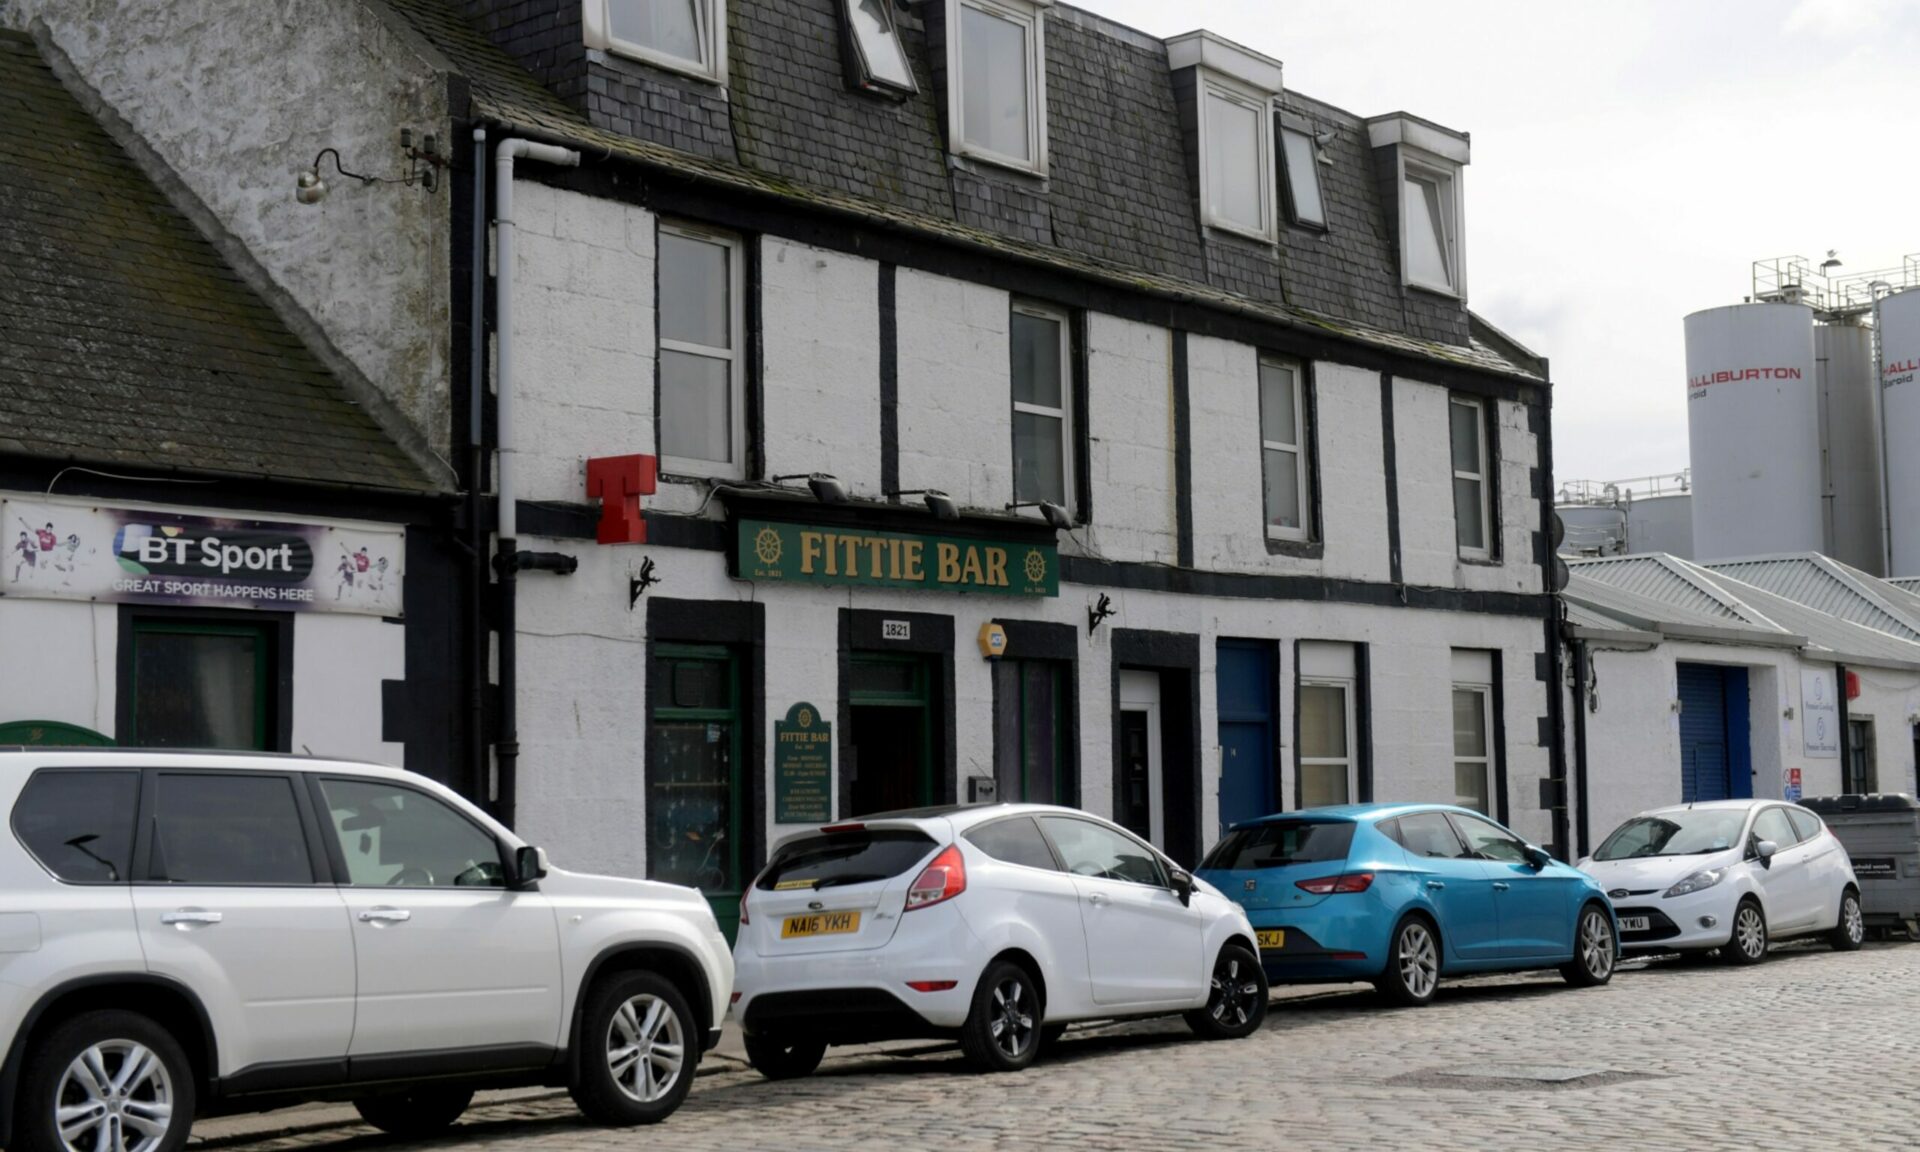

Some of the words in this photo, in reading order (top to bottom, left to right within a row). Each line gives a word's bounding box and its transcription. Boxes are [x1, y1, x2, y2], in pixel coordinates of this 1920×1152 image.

[1689, 368, 1801, 388] ALLIBURTON
[139, 536, 194, 565] BT
[200, 537, 293, 574] Sport
[800, 531, 925, 581] FITTIE
[936, 542, 1010, 587] BAR
[112, 579, 163, 594] GREAT
[164, 581, 210, 596] SPORT
[213, 584, 277, 600] HAPPENS
[279, 587, 314, 602] HERE
[885, 623, 907, 637] 1821
[780, 732, 809, 742] FITTIE
[811, 732, 829, 742] BAR
[824, 914, 850, 930] YKH
[1257, 933, 1280, 946] SKJ
